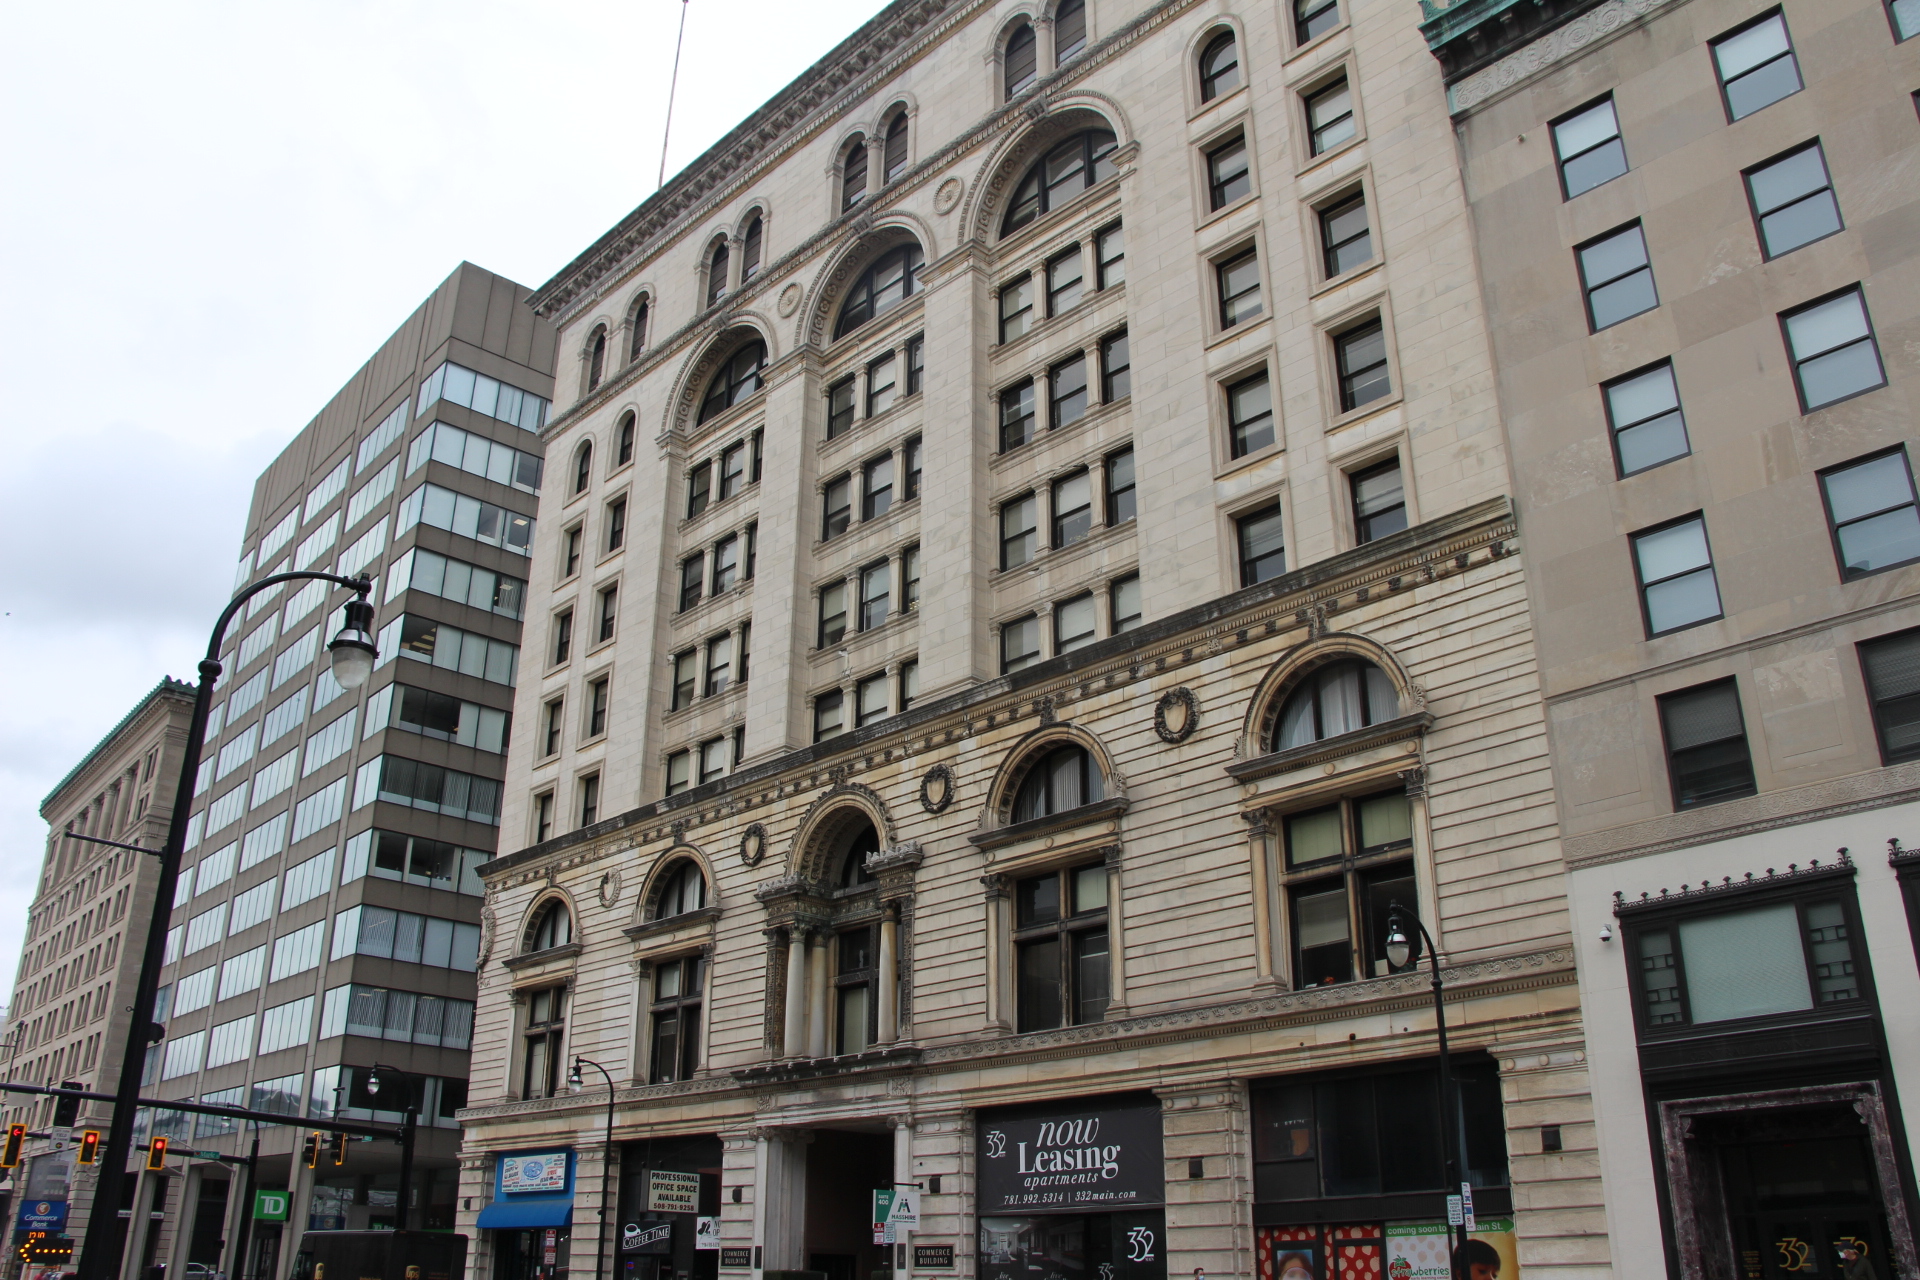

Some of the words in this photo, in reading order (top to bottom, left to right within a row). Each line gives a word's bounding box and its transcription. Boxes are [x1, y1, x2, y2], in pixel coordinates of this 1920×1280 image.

[1036, 1117, 1100, 1148] now
[986, 1130, 1006, 1158] 332
[1017, 1141, 1121, 1180] Leasing
[652, 1172, 699, 1183] PROFESSIONAL
[1024, 1172, 1099, 1190] apartments
[652, 1183, 674, 1191] OFFICE
[677, 1185, 697, 1193] SPACE
[260, 1195, 285, 1215] TD
[658, 1193, 691, 1203] AVAILABLE
[1004, 1191, 1063, 1205] 781.992.5314
[1075, 1190, 1137, 1201] 332main.com
[24, 1214, 58, 1222] Commerce
[1387, 1228, 1416, 1236] coming
[1439, 1224, 1447, 1232] to
[1476, 1223, 1489, 1231] ain
[1491, 1221, 1503, 1230] St.
[624, 1233, 649, 1248] COFFEE
[650, 1228, 669, 1240] TIME
[1127, 1226, 1155, 1262] 332
[917, 1248, 950, 1256] COMMERCE
[1775, 1237, 1812, 1271] 332
[1391, 1266, 1449, 1278] strawberries
